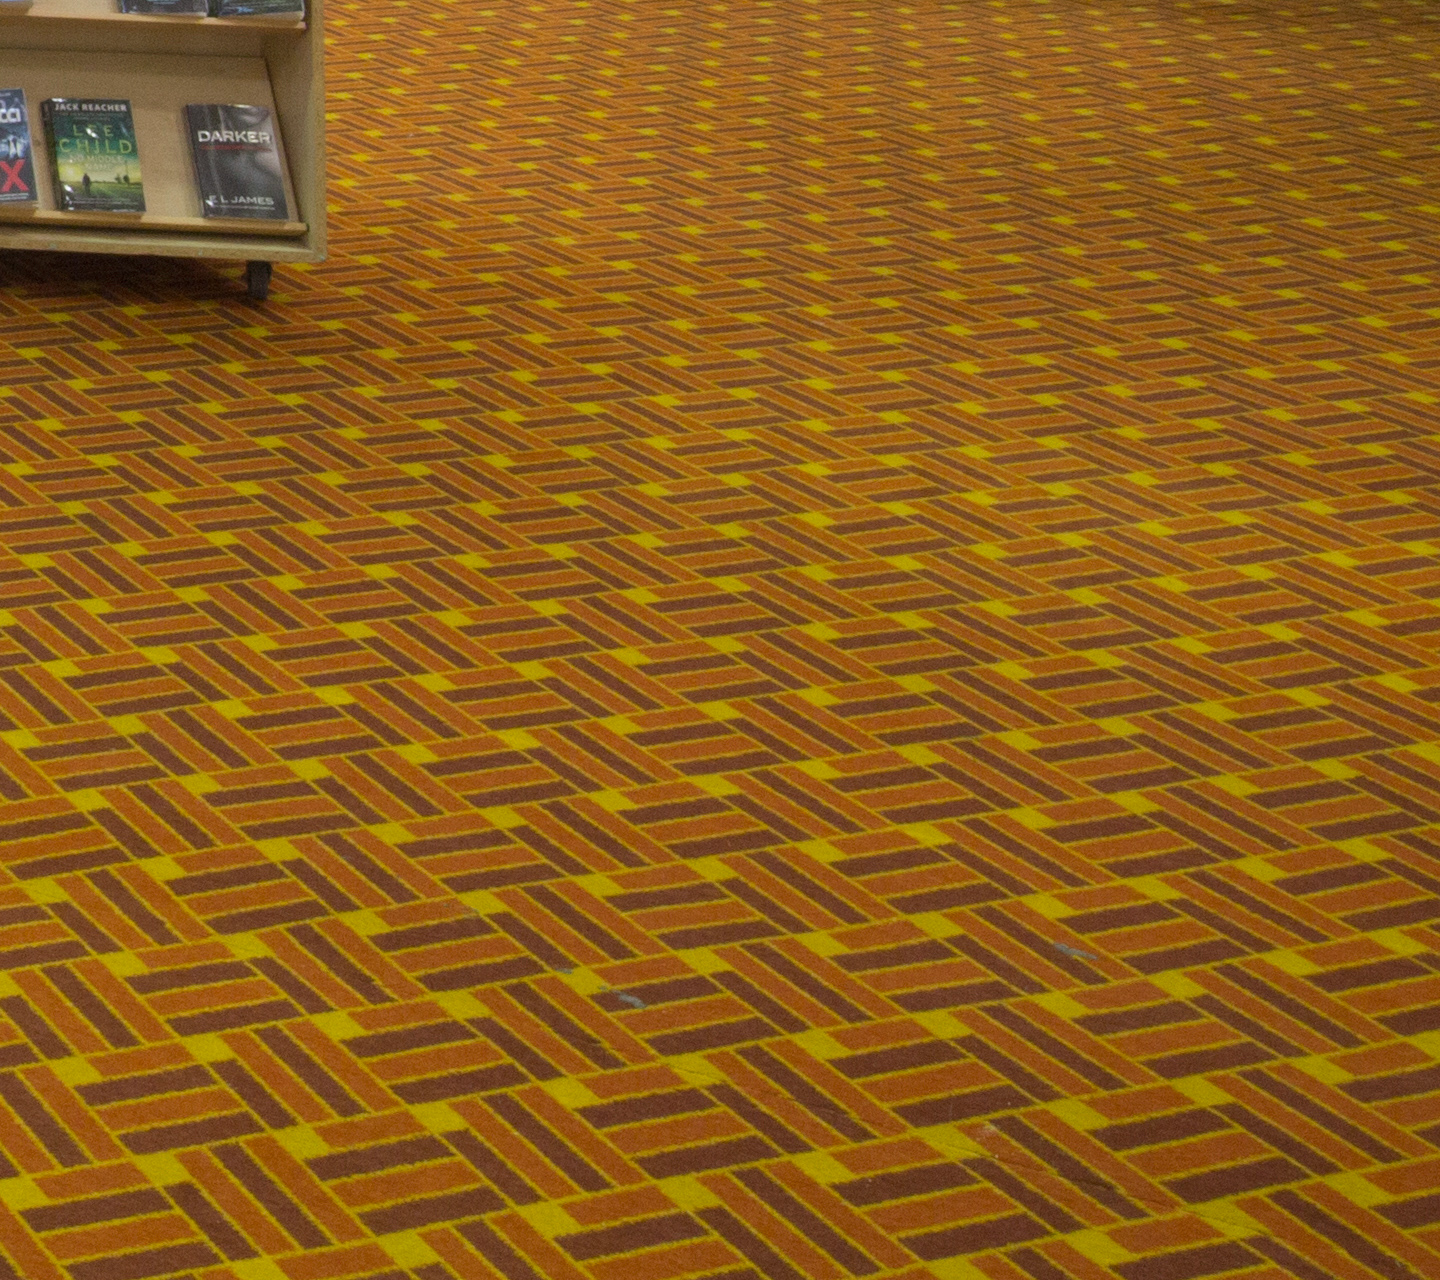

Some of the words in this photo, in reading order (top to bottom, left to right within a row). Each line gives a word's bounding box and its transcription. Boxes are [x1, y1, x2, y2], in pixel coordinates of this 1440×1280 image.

[54, 103, 79, 112] JACK
[82, 103, 127, 112] REACHER
[198, 130, 270, 144] DARKER
[59, 139, 131, 154] CHILD
[231, 196, 274, 205] JAMES
